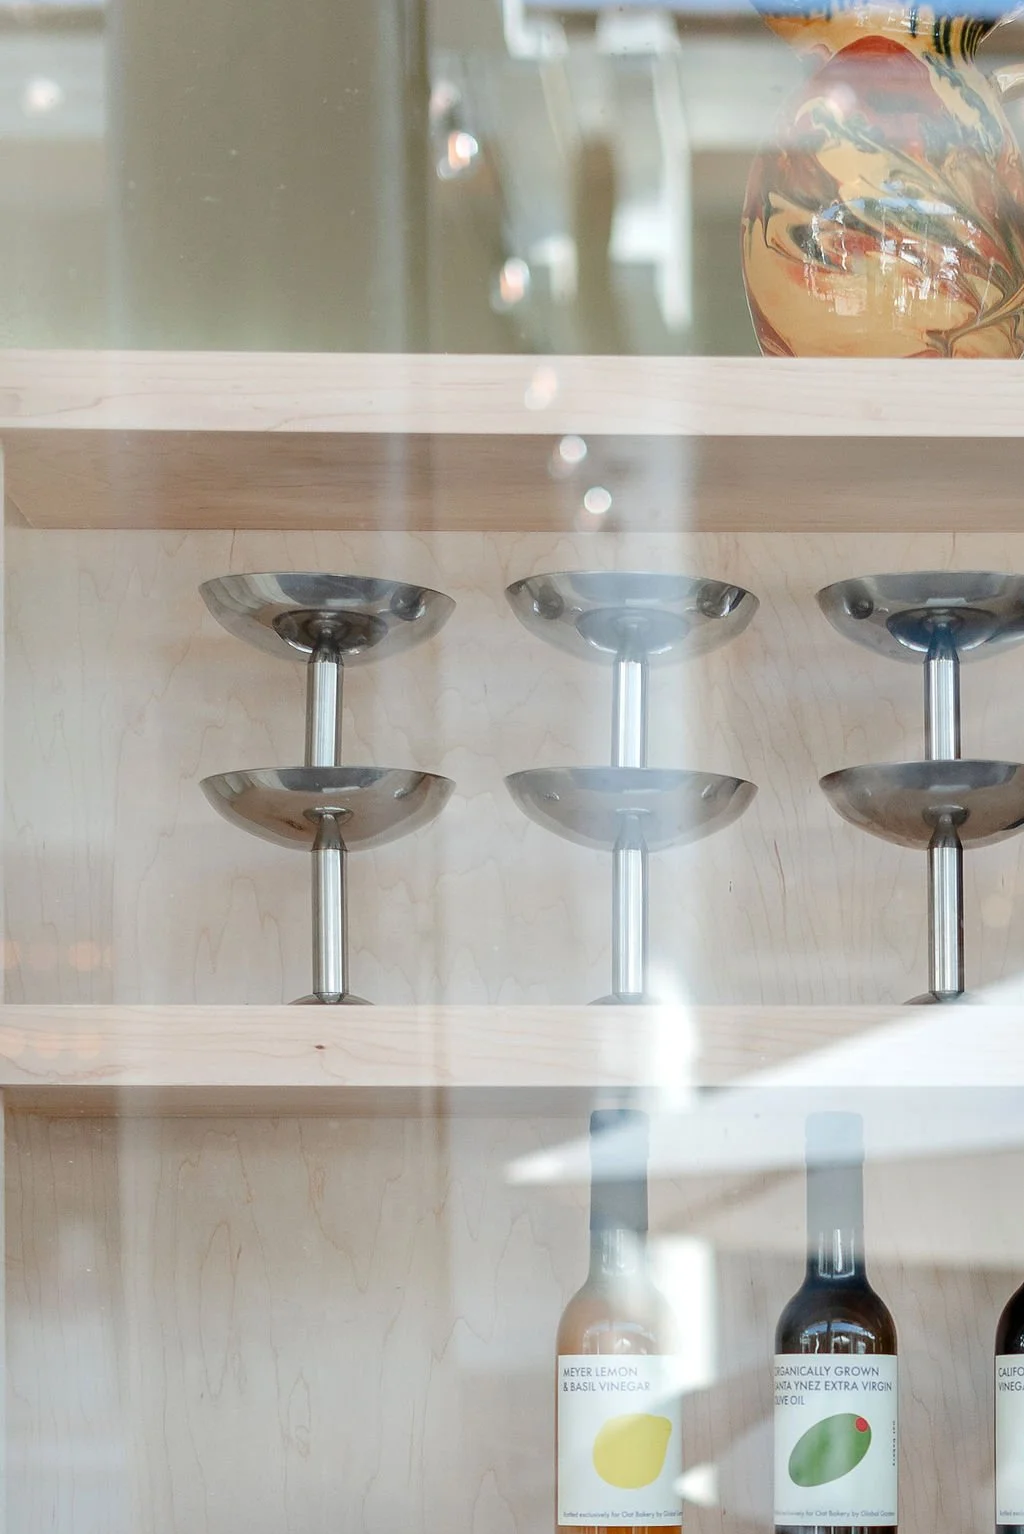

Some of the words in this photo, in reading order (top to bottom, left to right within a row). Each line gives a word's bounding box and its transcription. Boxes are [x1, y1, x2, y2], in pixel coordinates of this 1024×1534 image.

[563, 1367, 593, 1377] MEYER
[595, 1366, 638, 1377] LEMON
[834, 1366, 880, 1377] GROWN
[563, 1382, 569, 1392] &
[570, 1382, 596, 1392] BASIL
[598, 1381, 650, 1391] VINEGAR
[774, 1381, 792, 1391] ANTA
[793, 1381, 821, 1391] YNEZ
[824, 1381, 859, 1391] EXTRA
[861, 1381, 893, 1391] VIRGIN
[790, 1395, 805, 1406] OIL
